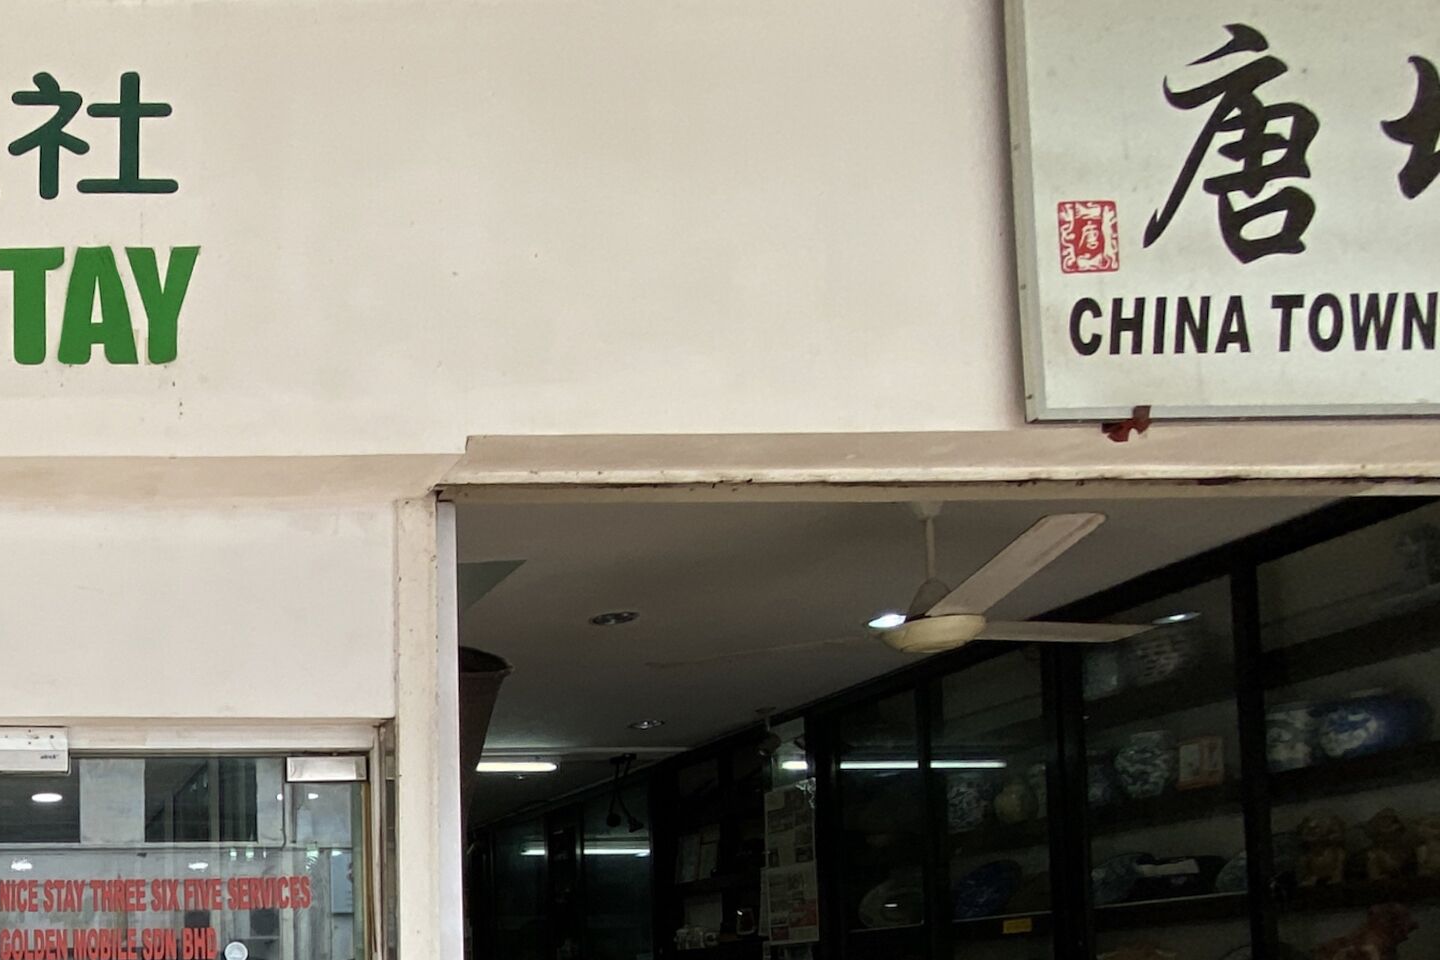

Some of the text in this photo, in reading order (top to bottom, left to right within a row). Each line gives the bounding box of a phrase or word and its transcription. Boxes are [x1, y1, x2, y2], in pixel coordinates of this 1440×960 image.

[1069, 292, 1440, 355] CHINA TOWN
[43, 879, 86, 912] STAY
[90, 878, 147, 911] THREE
[151, 877, 179, 911] SIX
[183, 877, 222, 910] FIVE
[227, 875, 311, 910] SERVICES
[73, 928, 137, 960] MOBILE
[142, 928, 178, 960] SDN
[183, 927, 217, 960] BHD
